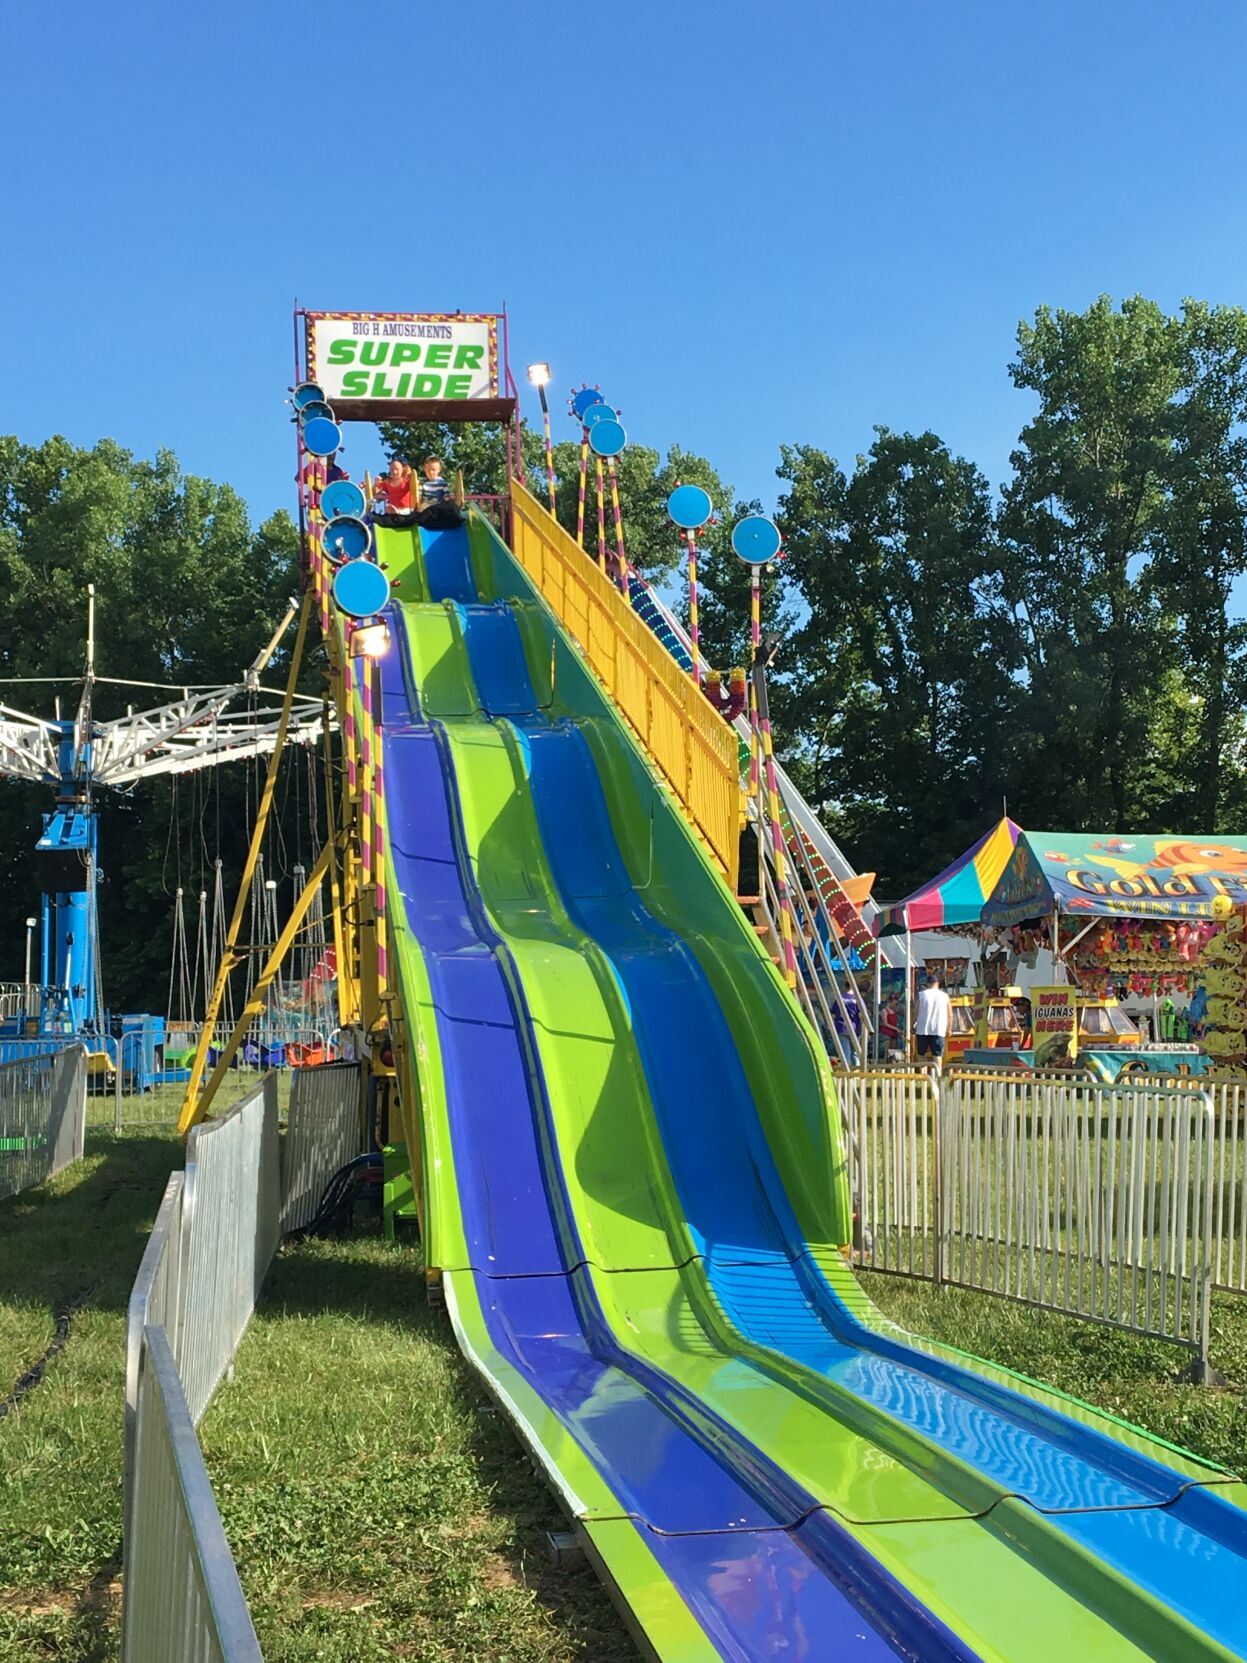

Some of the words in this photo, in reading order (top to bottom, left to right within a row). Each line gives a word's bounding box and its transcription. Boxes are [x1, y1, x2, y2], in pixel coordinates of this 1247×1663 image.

[352, 322, 370, 336] BIG
[373, 323, 380, 336] H
[382, 323, 453, 339] AMUSEMENTS
[327, 339, 485, 370] SUPER
[340, 370, 473, 400] SLIDE
[1066, 869, 1206, 898] Gold
[1105, 899, 1172, 915] WIN
[1039, 993, 1068, 1005] WIN
[1034, 1005, 1074, 1019] IGUANAS
[1035, 1019, 1074, 1033] HERE
